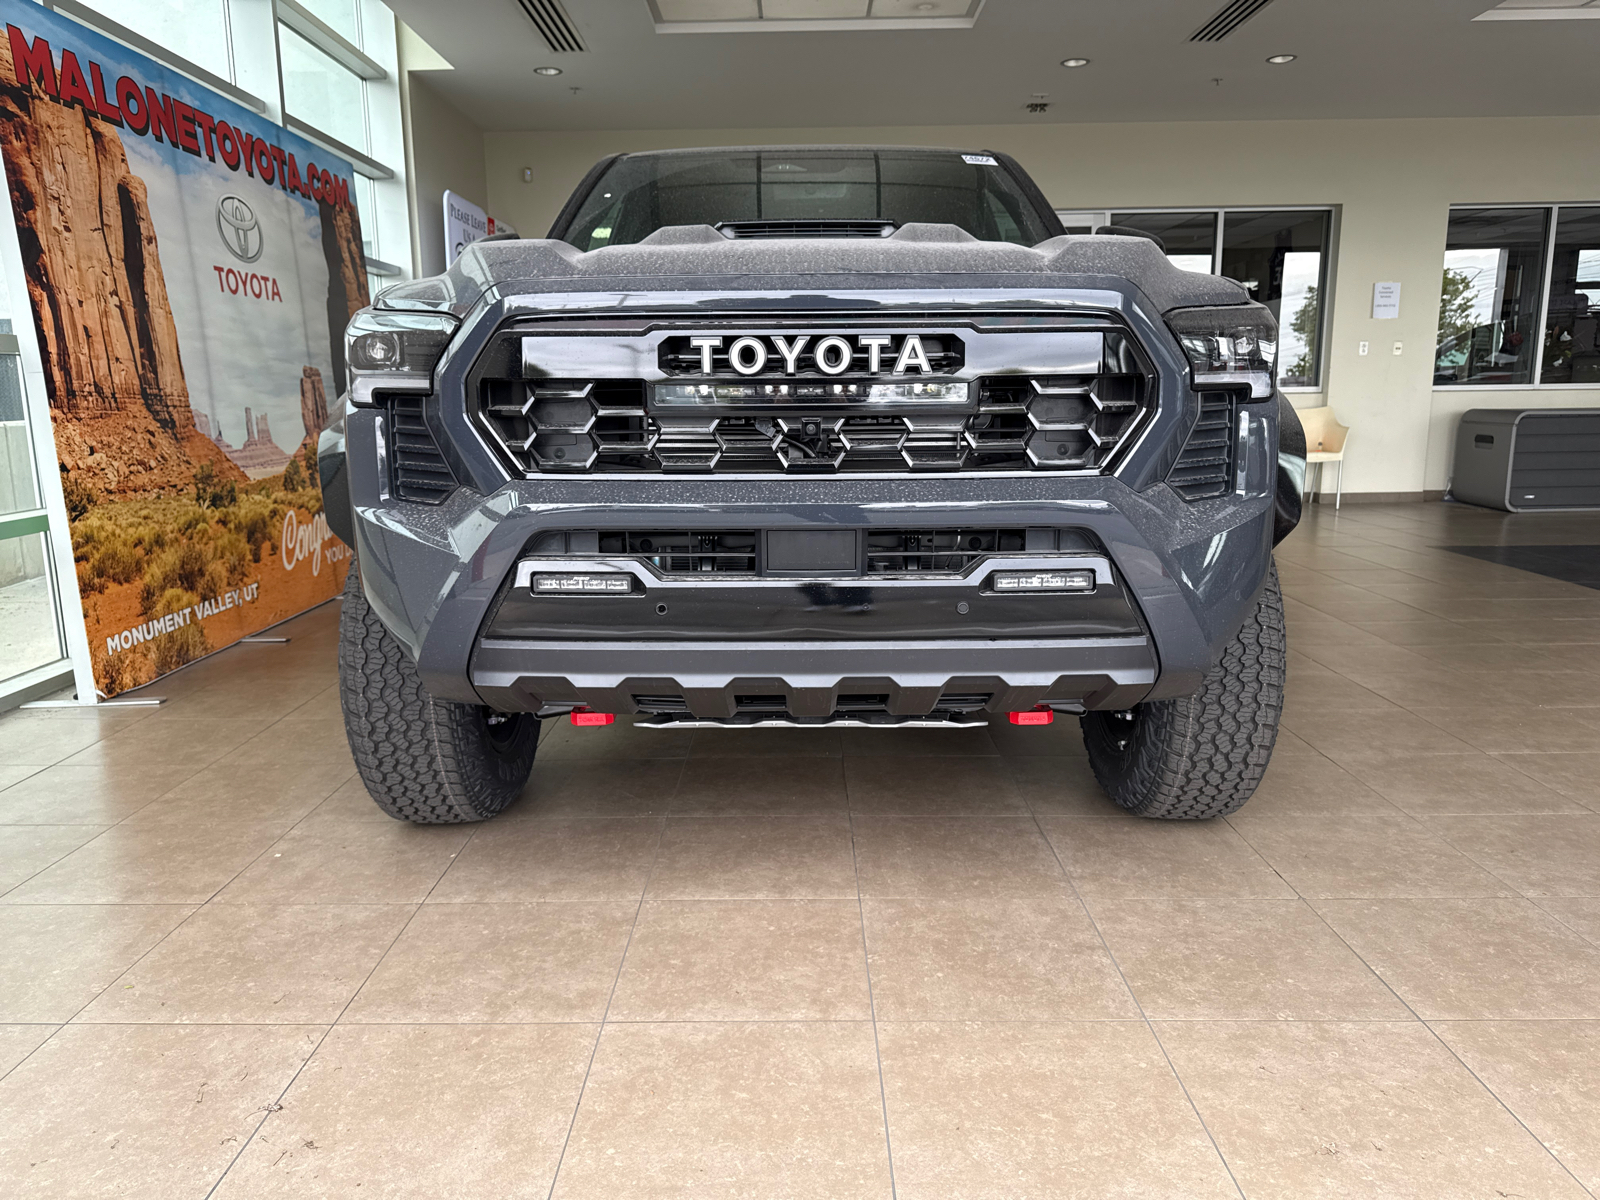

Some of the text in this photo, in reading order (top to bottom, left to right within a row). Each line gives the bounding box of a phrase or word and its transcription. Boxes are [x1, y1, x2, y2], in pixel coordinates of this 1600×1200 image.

[6, 23, 351, 208] MALONETOYOTA.COM
[213, 265, 283, 303] TOYOTA
[690, 334, 933, 377] TOYOTA
[282, 510, 334, 577] Congr
[325, 544, 343, 564] YOU
[106, 582, 259, 656] MONUMENT VALLEY, UT
